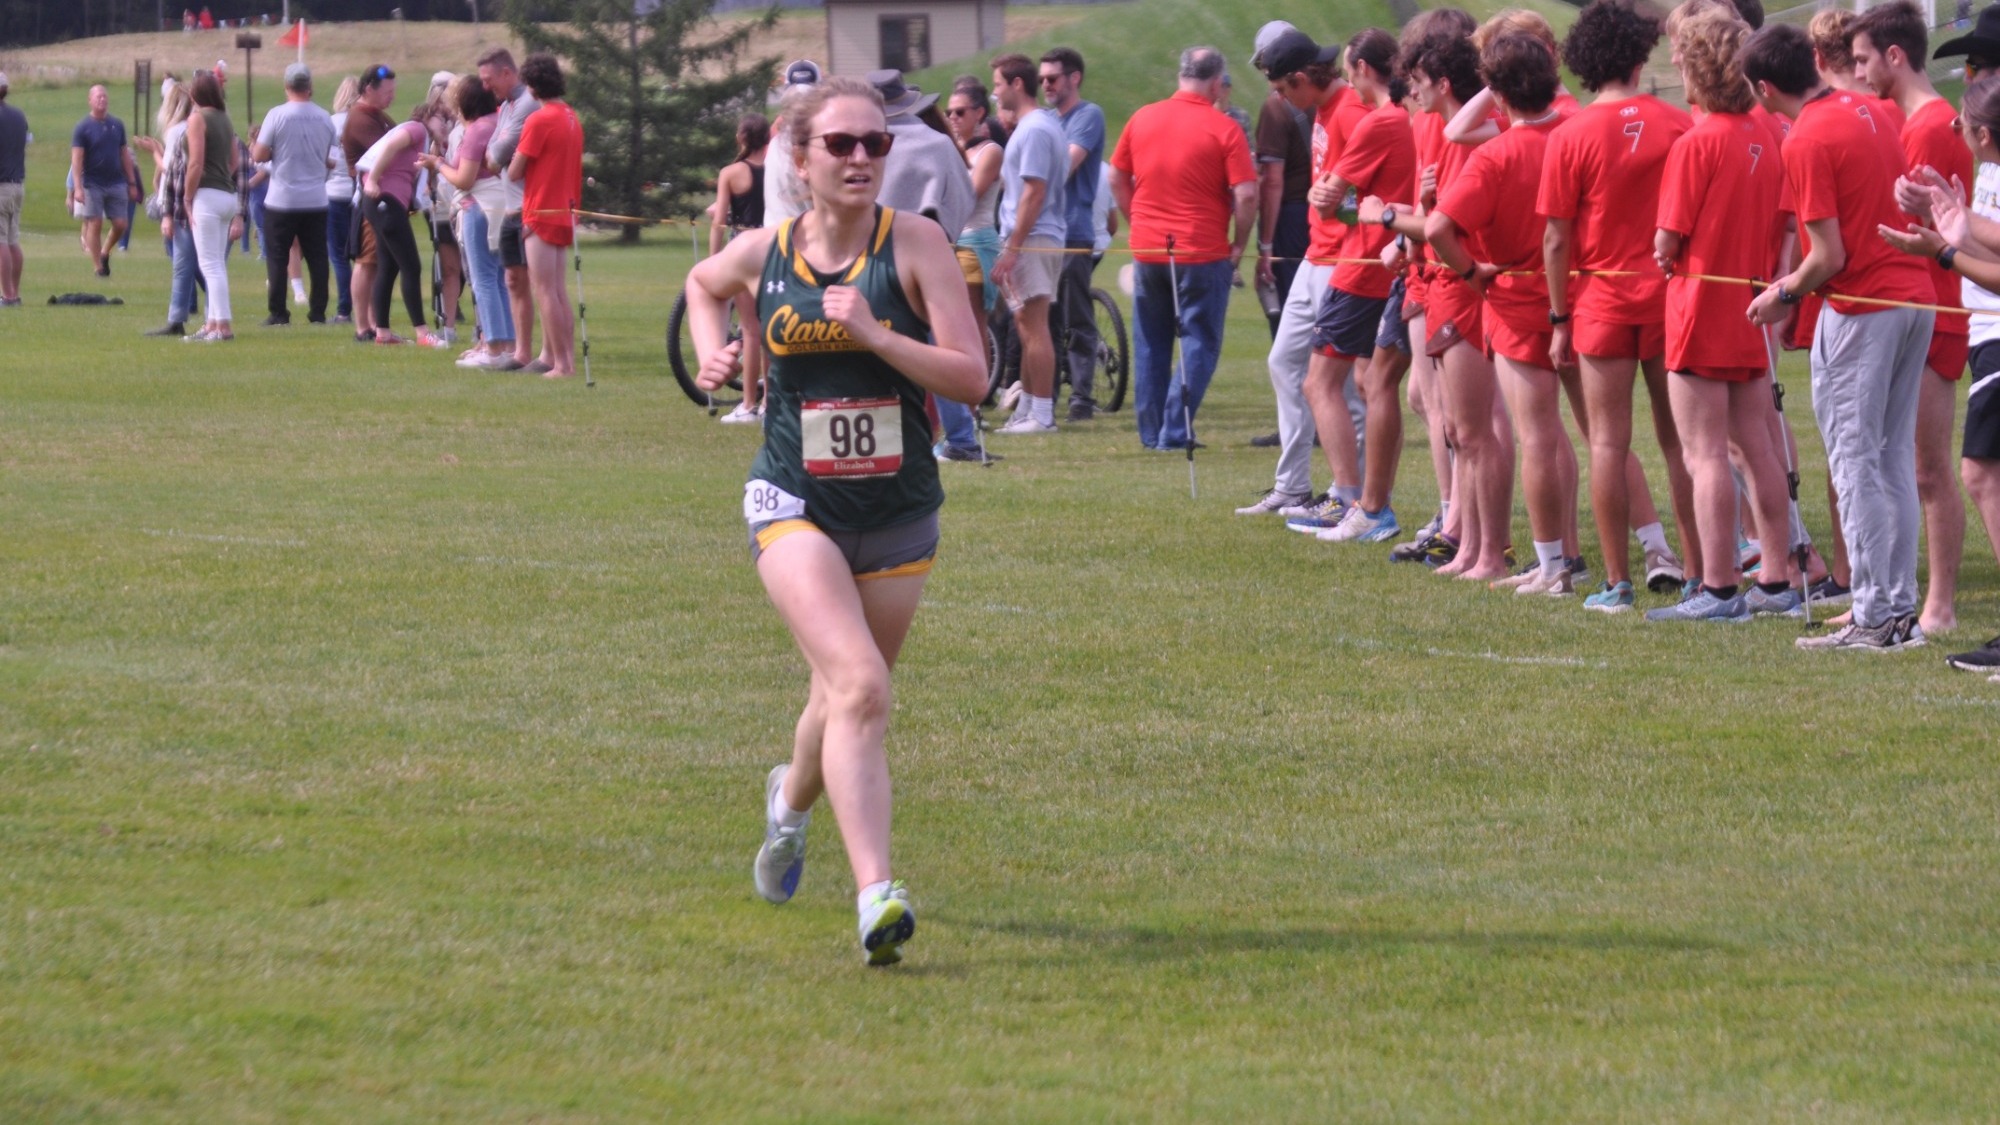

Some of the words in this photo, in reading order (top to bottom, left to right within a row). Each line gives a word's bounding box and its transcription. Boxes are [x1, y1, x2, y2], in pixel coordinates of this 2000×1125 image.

[829, 412, 876, 458] 98
[833, 460, 875, 471] Elizabeth
[753, 487, 779, 513] 98
